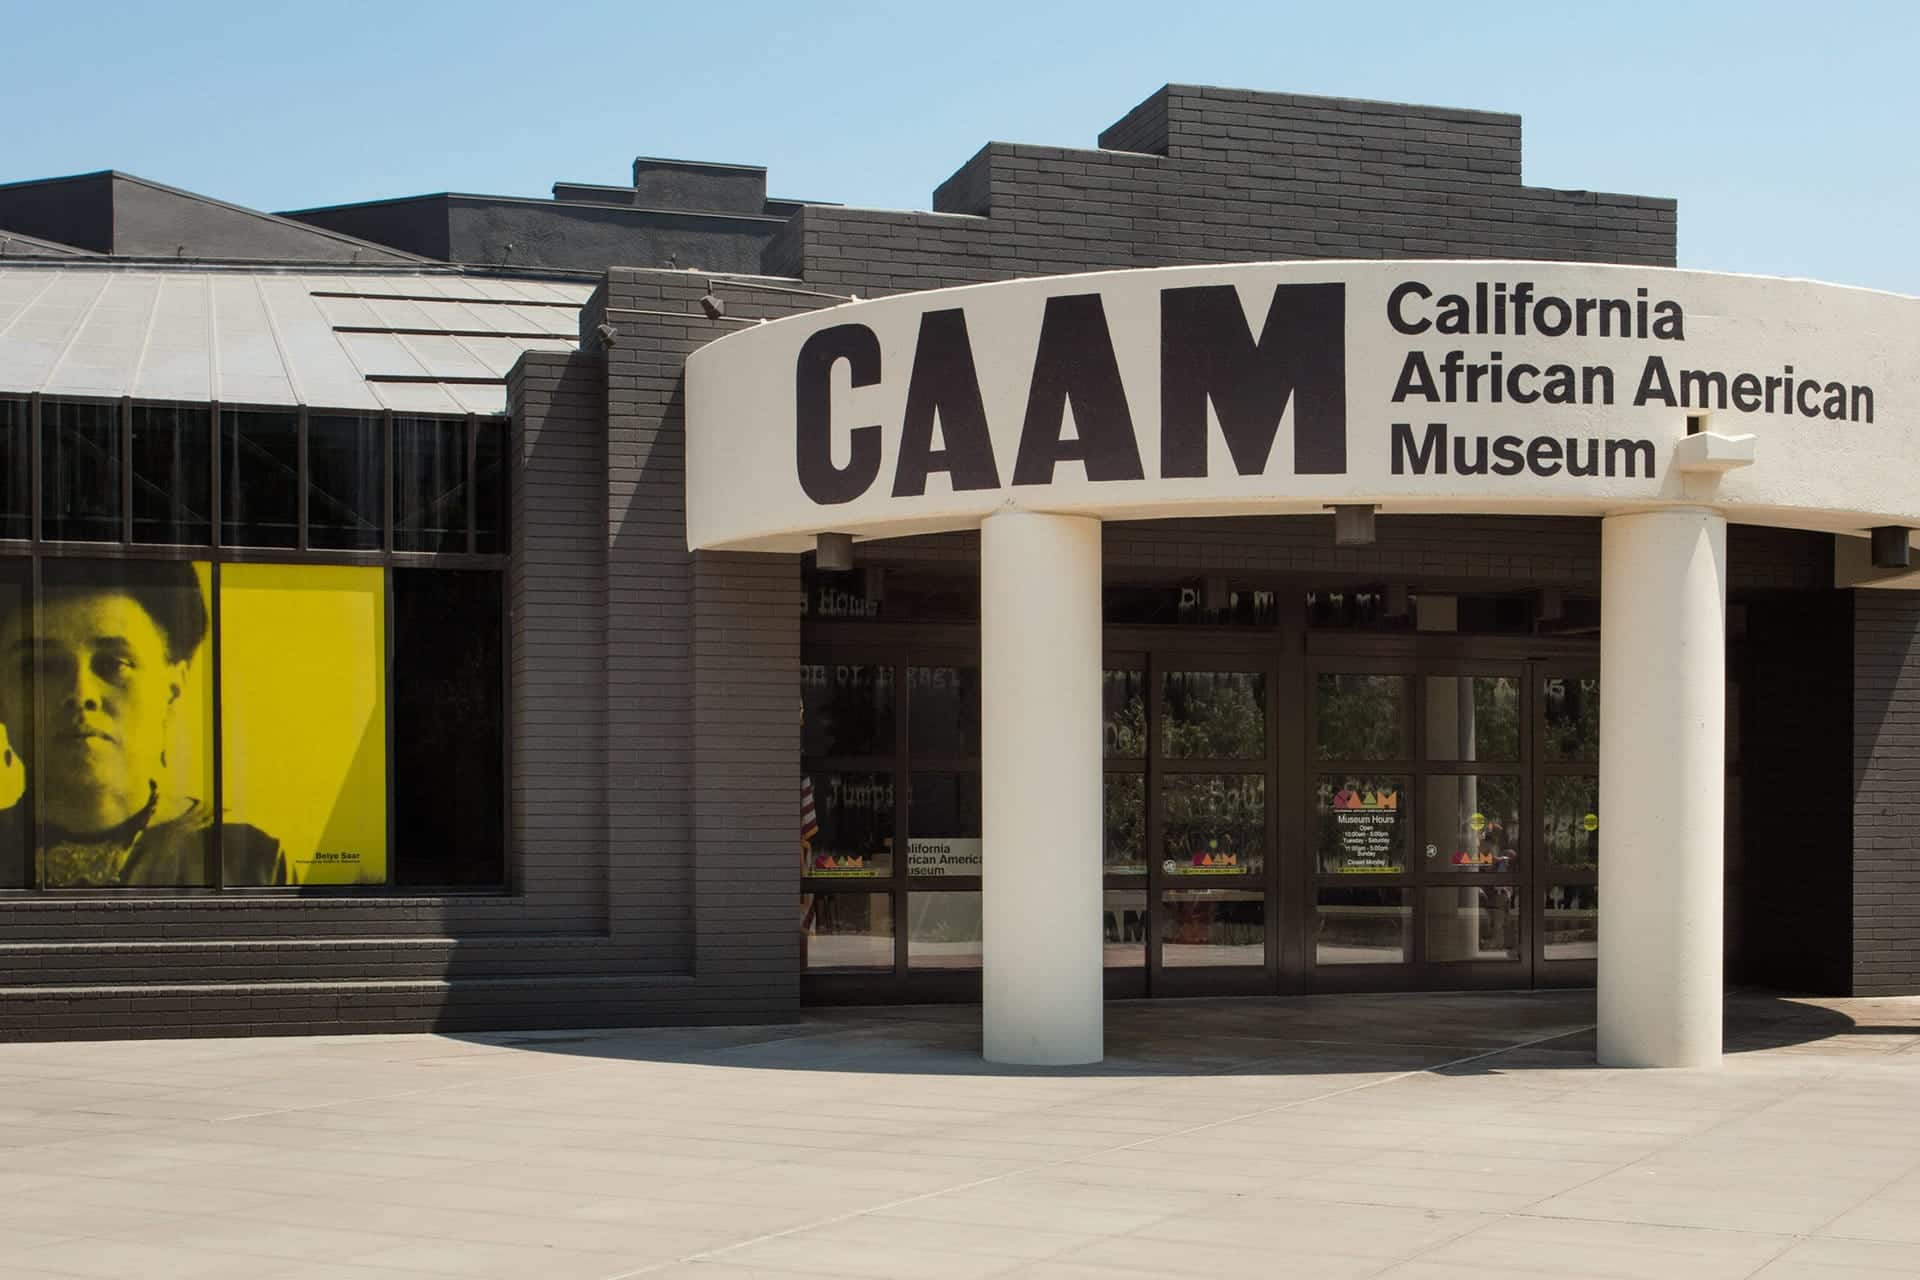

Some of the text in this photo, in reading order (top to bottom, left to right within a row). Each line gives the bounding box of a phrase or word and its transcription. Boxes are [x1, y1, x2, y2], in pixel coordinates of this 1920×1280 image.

[1387, 280, 1685, 342] California
[796, 281, 1347, 506] CAAM
[1391, 350, 1874, 424] African American
[1390, 422, 1656, 479] Museum
[1338, 815, 1394, 823] Museum Hours
[908, 866, 945, 876] useum
